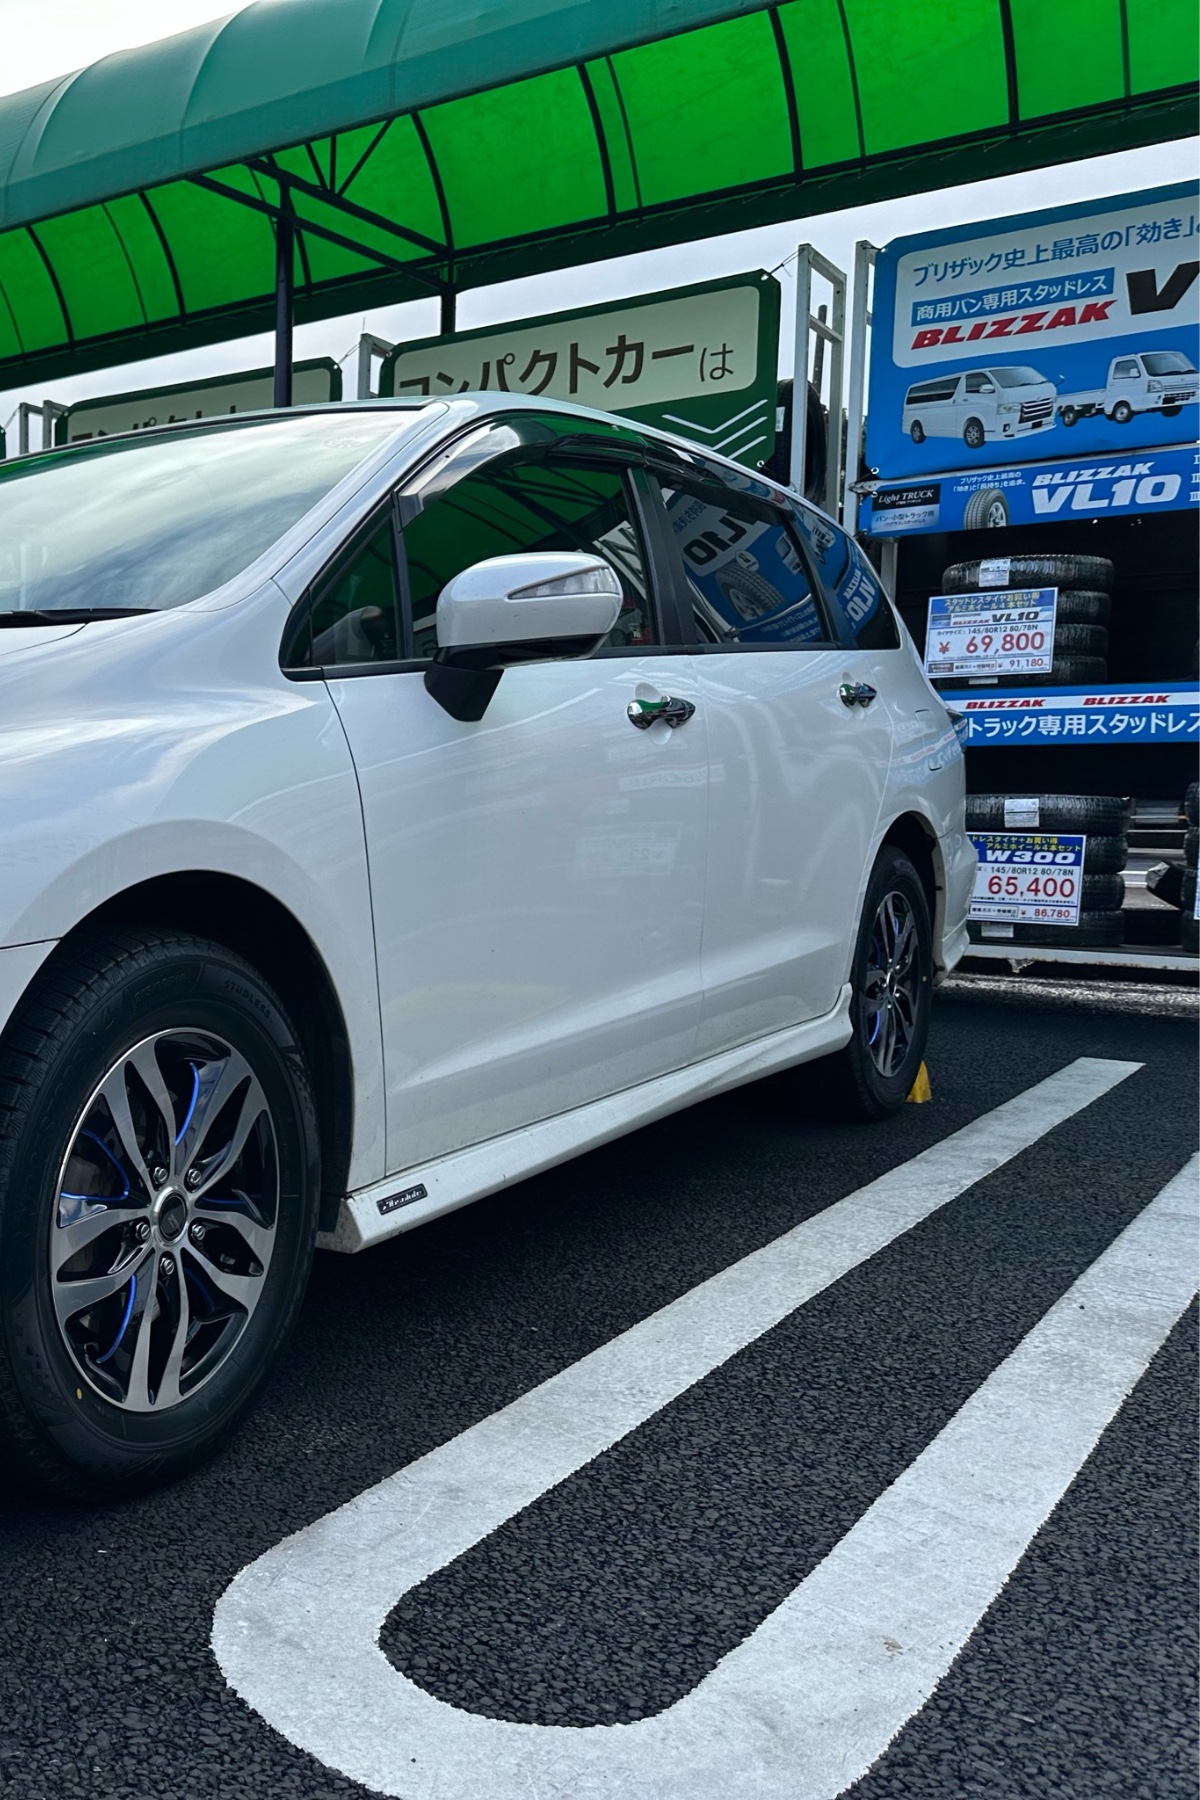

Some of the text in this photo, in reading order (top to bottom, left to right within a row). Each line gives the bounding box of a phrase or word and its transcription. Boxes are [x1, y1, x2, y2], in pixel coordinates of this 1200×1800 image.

[916, 274, 1108, 321] 商用バン専用スタッドレス
[910, 299, 1118, 350] BLIZZAK
[1032, 461, 1156, 487] BLIZZAK
[878, 493, 901, 505] Light
[901, 489, 935, 501] TRUCK
[1031, 473, 1182, 514] VL10
[991, 611, 1040, 623] VL10
[968, 625, 1008, 635] 145/80R12
[1009, 624, 1038, 633] 80/78N
[939, 631, 1045, 655] ¥ 69,800
[1009, 658, 1044, 670] 91,180
[965, 698, 1047, 710] BLIZZAK
[1083, 694, 1172, 706] BLIZZAK
[986, 842, 1081, 852] アルミホイール4本セット
[986, 850, 1076, 864] W300
[990, 866, 1038, 875] 145/80R12
[1041, 867, 1074, 876] 80/78N
[988, 875, 1075, 898] 65,400
[223, 979, 272, 1020] STUDLESS
